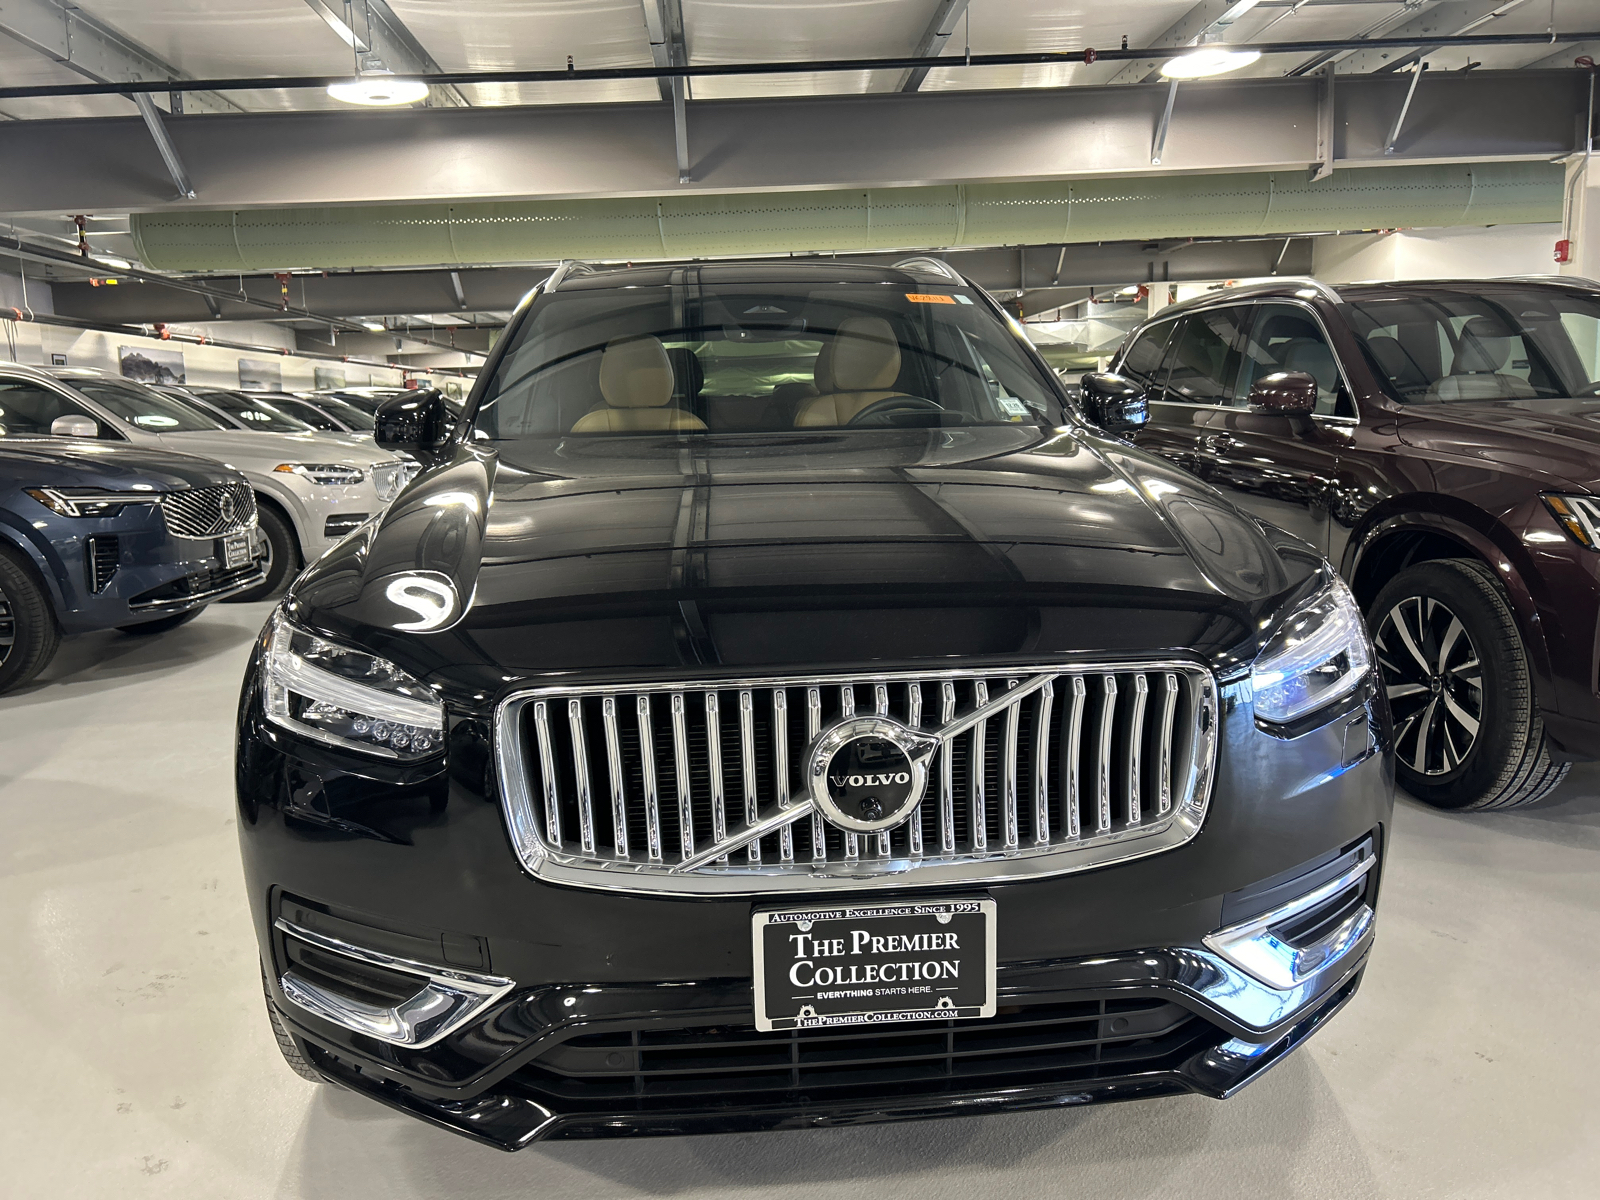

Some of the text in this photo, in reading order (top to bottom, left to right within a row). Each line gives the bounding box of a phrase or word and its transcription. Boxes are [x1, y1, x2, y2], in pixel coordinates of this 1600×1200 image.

[830, 772, 910, 787] VOLVO
[771, 903, 979, 923] AUTOMOTIVE EXCELLENCE SINCE 1995
[789, 930, 960, 958] THE PREMIER
[789, 960, 961, 987] COLLECTION
[817, 985, 933, 1000] EVERYTHING STARTS HERE.
